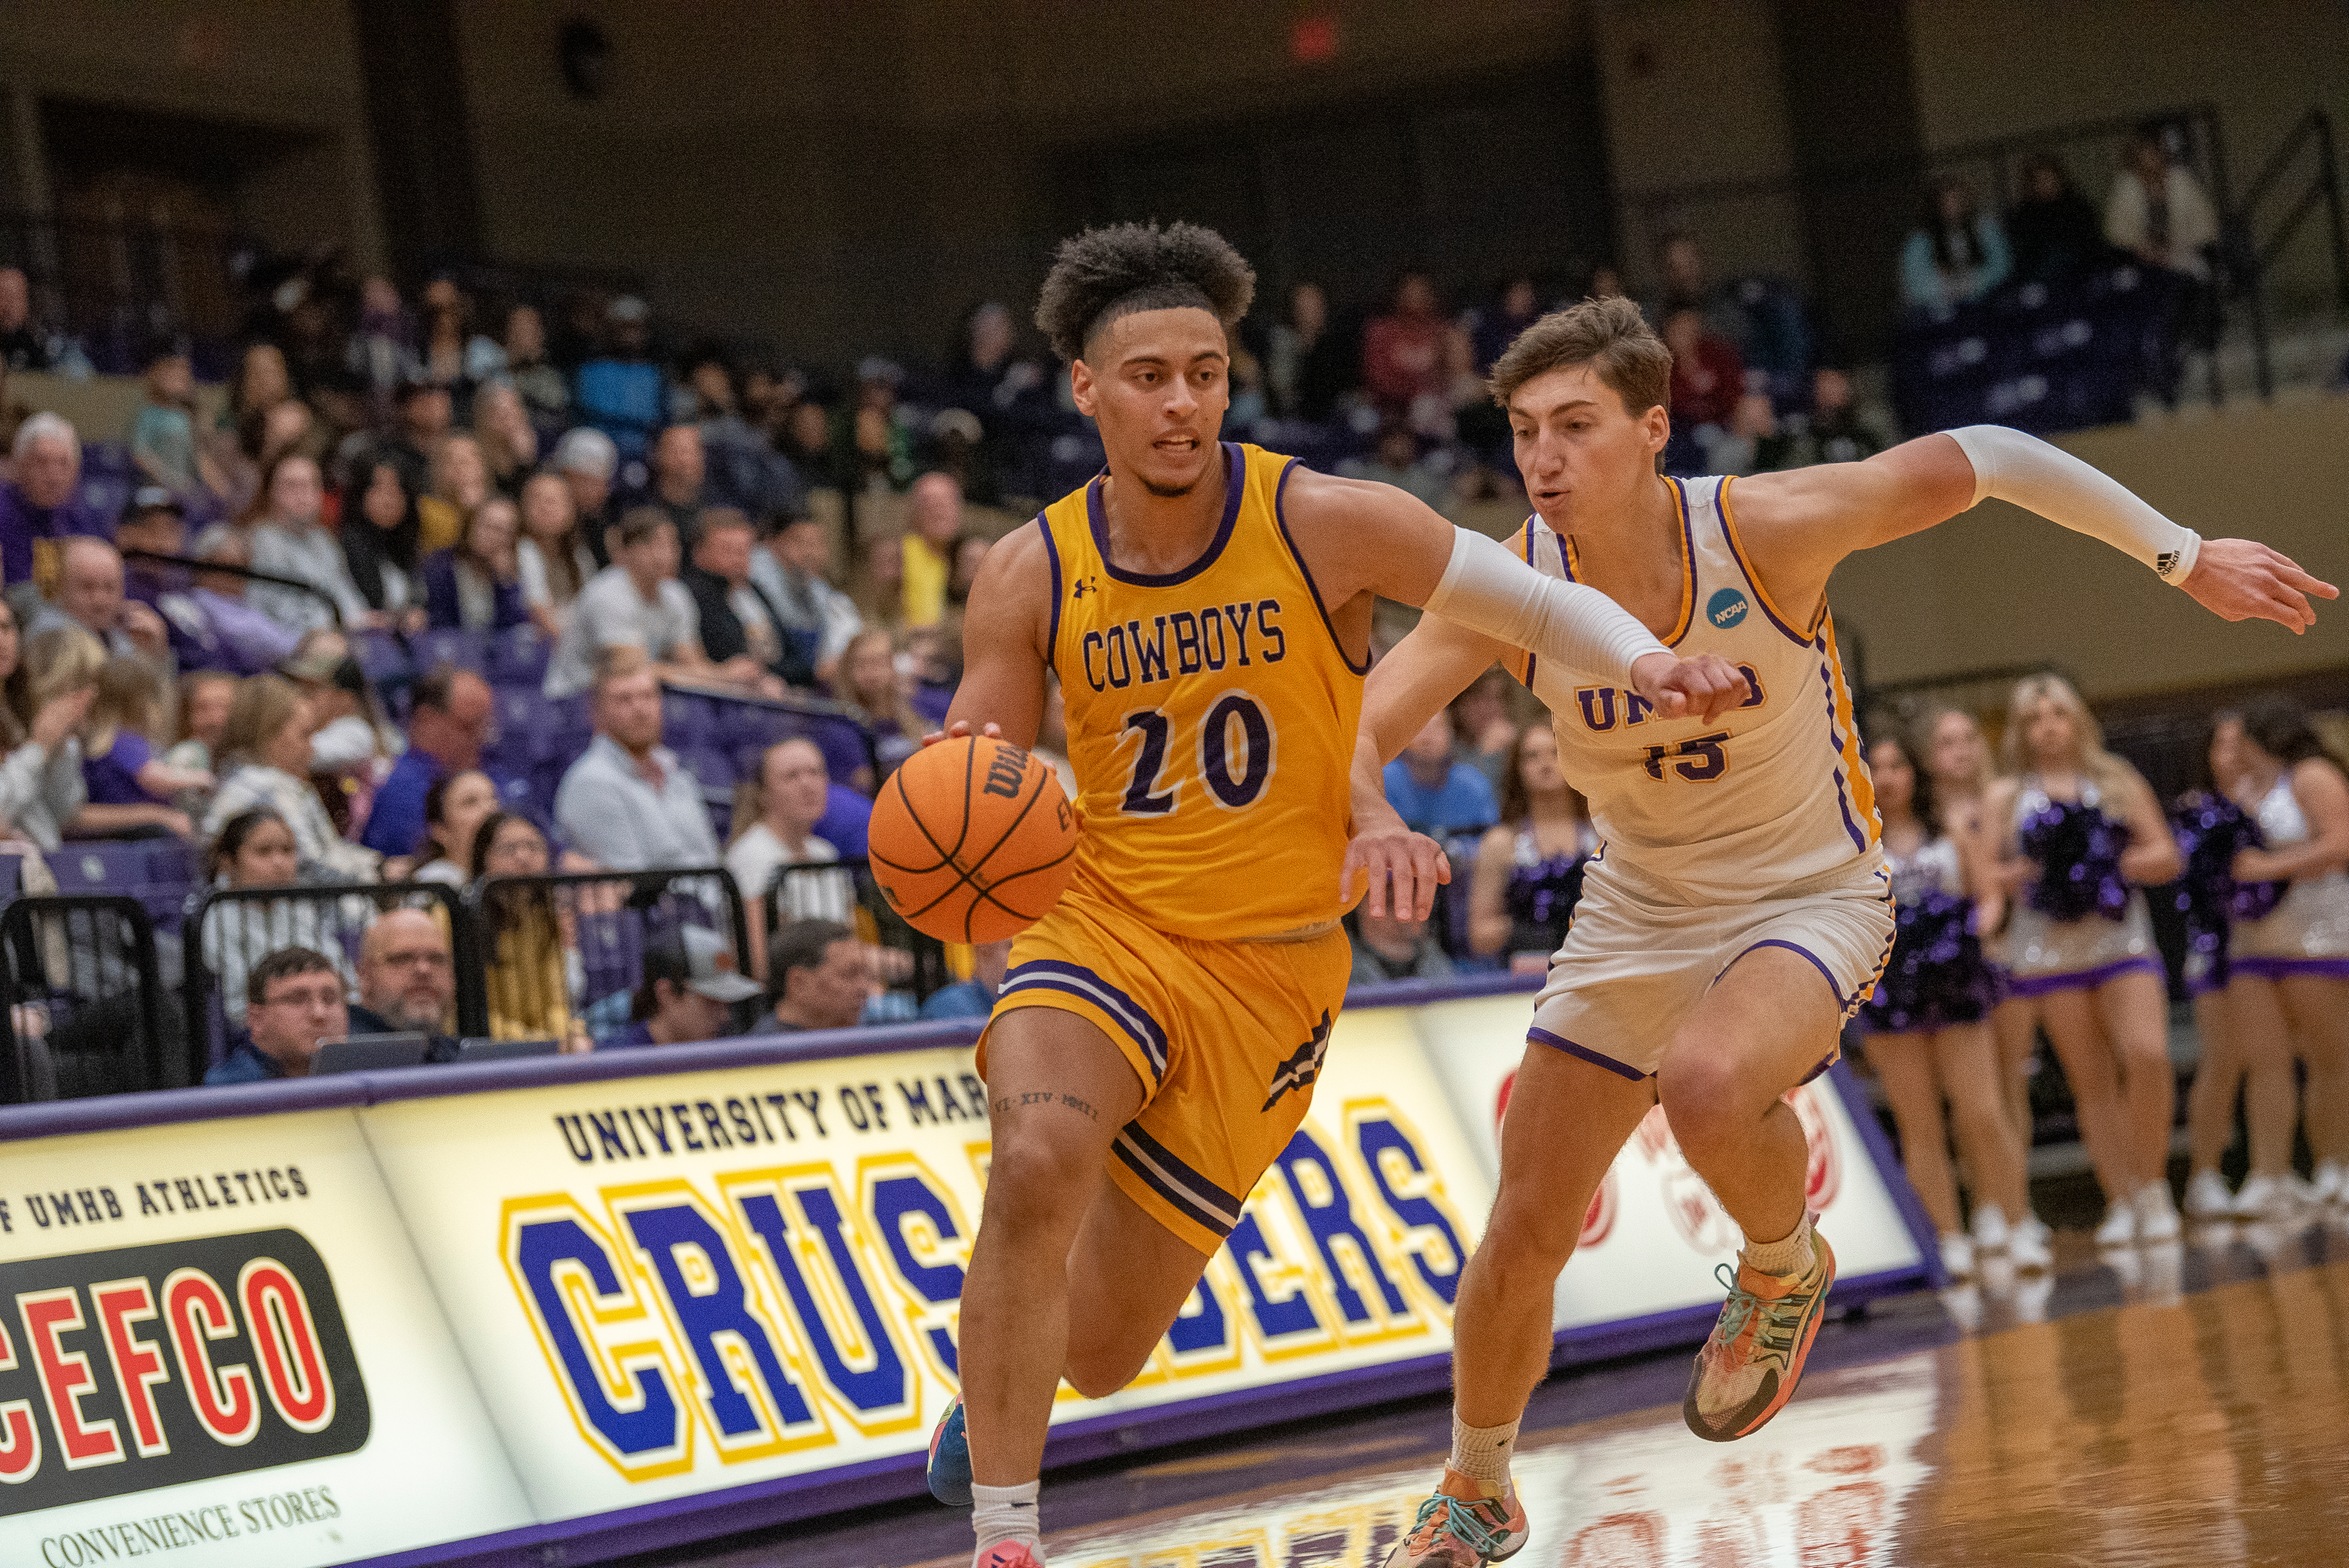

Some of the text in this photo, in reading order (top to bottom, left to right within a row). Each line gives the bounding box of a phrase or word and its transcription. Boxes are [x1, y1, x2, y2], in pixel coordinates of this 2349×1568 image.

[1083, 599, 1286, 693] COWBOYS
[1714, 600, 1748, 624] NCAA
[1116, 688, 1278, 818] 20
[1641, 728, 1732, 783] 15
[555, 1073, 989, 1164] UNIVERSITY OF MAR
[25, 1186, 124, 1228] UMHB
[135, 1166, 310, 1216] ATHLETICS
[497, 1094, 1474, 1484] CRUSERS
[40, 1484, 342, 1568] CONVENIENCE STORES
